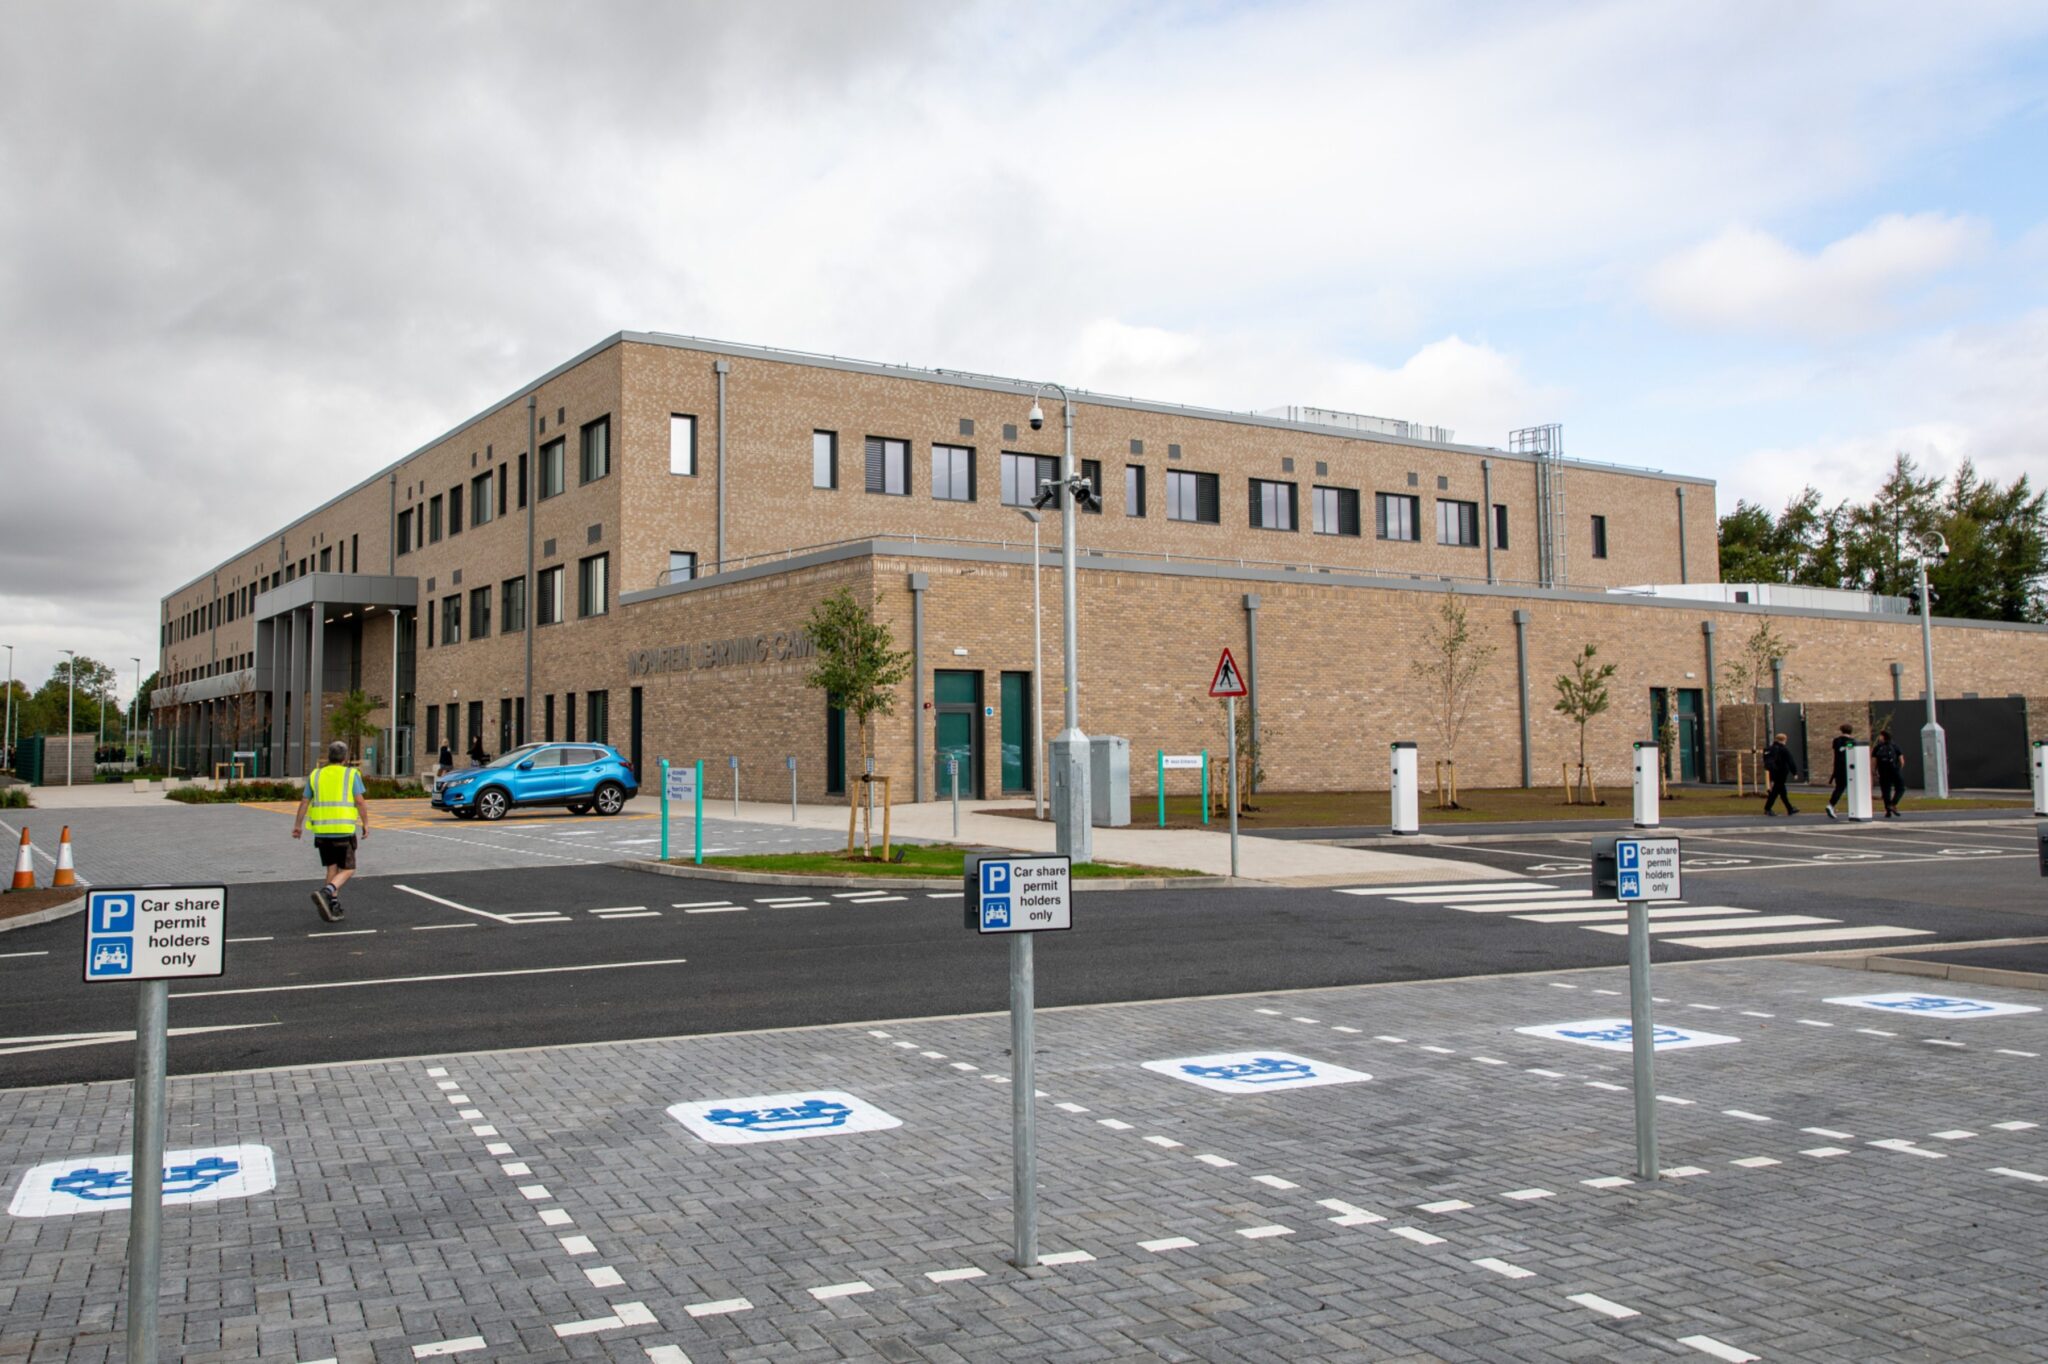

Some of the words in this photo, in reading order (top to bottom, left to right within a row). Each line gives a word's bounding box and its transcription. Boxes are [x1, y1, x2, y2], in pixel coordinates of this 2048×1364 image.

[697, 635, 768, 668] LEARNING
[1623, 846, 1636, 867] P
[1640, 846, 1654, 855] Car
[1656, 846, 1677, 855] share
[1647, 859, 1672, 869] permit
[1014, 867, 1033, 878] Car
[1036, 866, 1066, 876] share
[1645, 871, 1674, 879] holders
[989, 866, 1006, 892] P
[1023, 880, 1058, 894] permit
[1652, 882, 1668, 893] only
[141, 899, 170, 912] Car
[175, 898, 220, 911] share
[1020, 896, 1061, 906] holders
[102, 899, 129, 929] P
[1029, 910, 1053, 922] only
[154, 915, 206, 933] permit
[148, 935, 210, 948] holders
[161, 952, 196, 968] only
